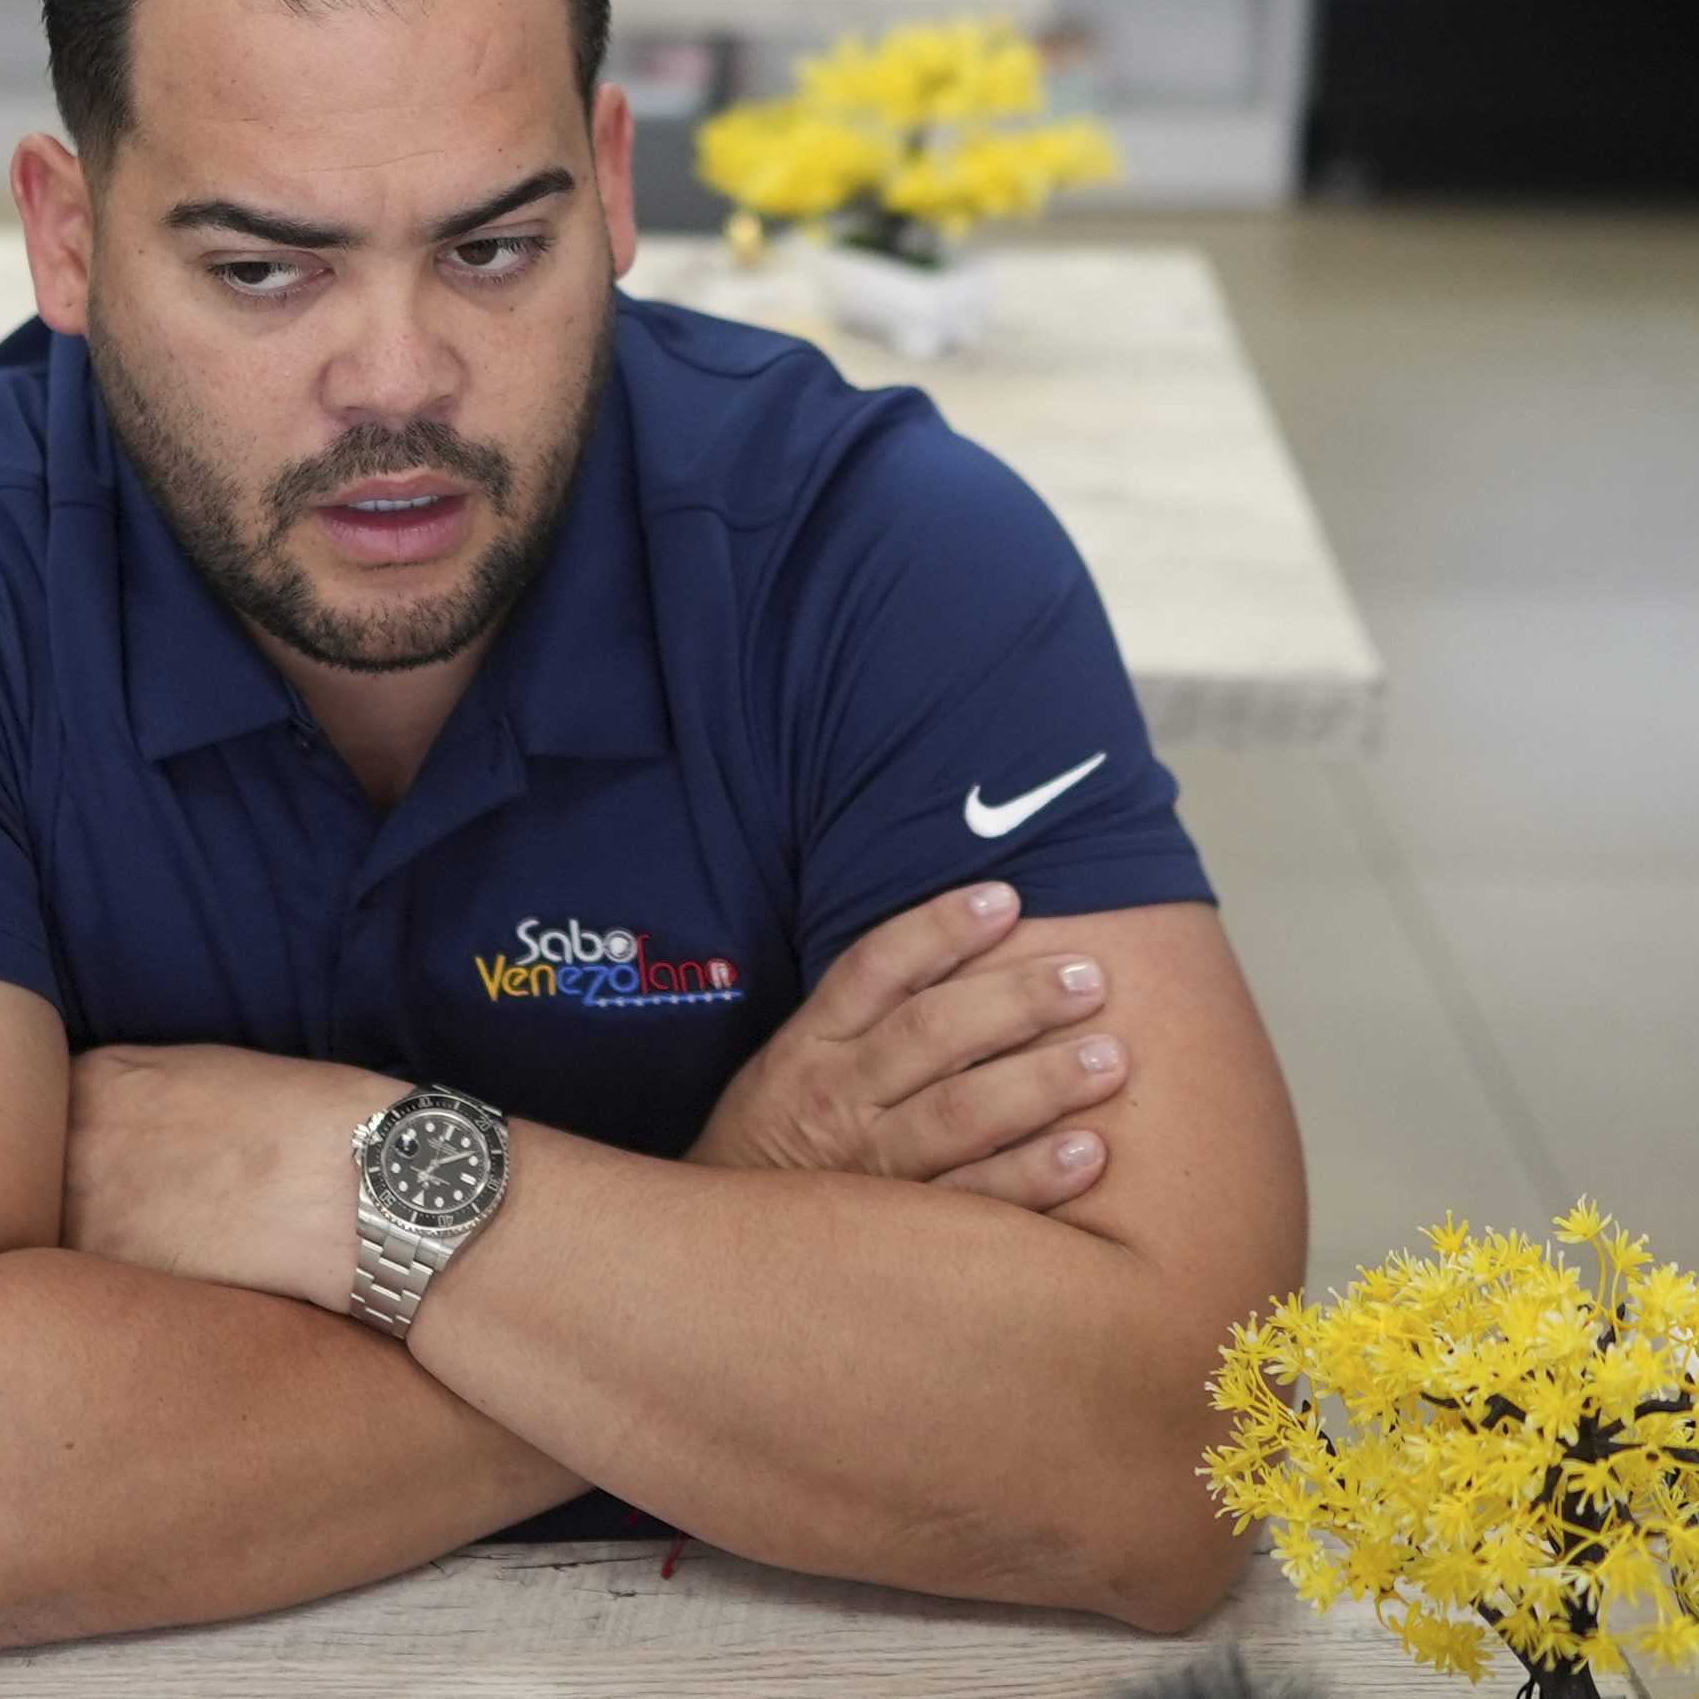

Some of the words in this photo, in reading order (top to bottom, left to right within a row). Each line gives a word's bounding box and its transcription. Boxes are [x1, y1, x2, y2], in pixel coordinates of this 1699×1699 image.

[474, 1116, 492, 1132] 20
[486, 1174, 502, 1192] 30
[379, 1189, 397, 1207] 50
[437, 1214, 454, 1227] 40
